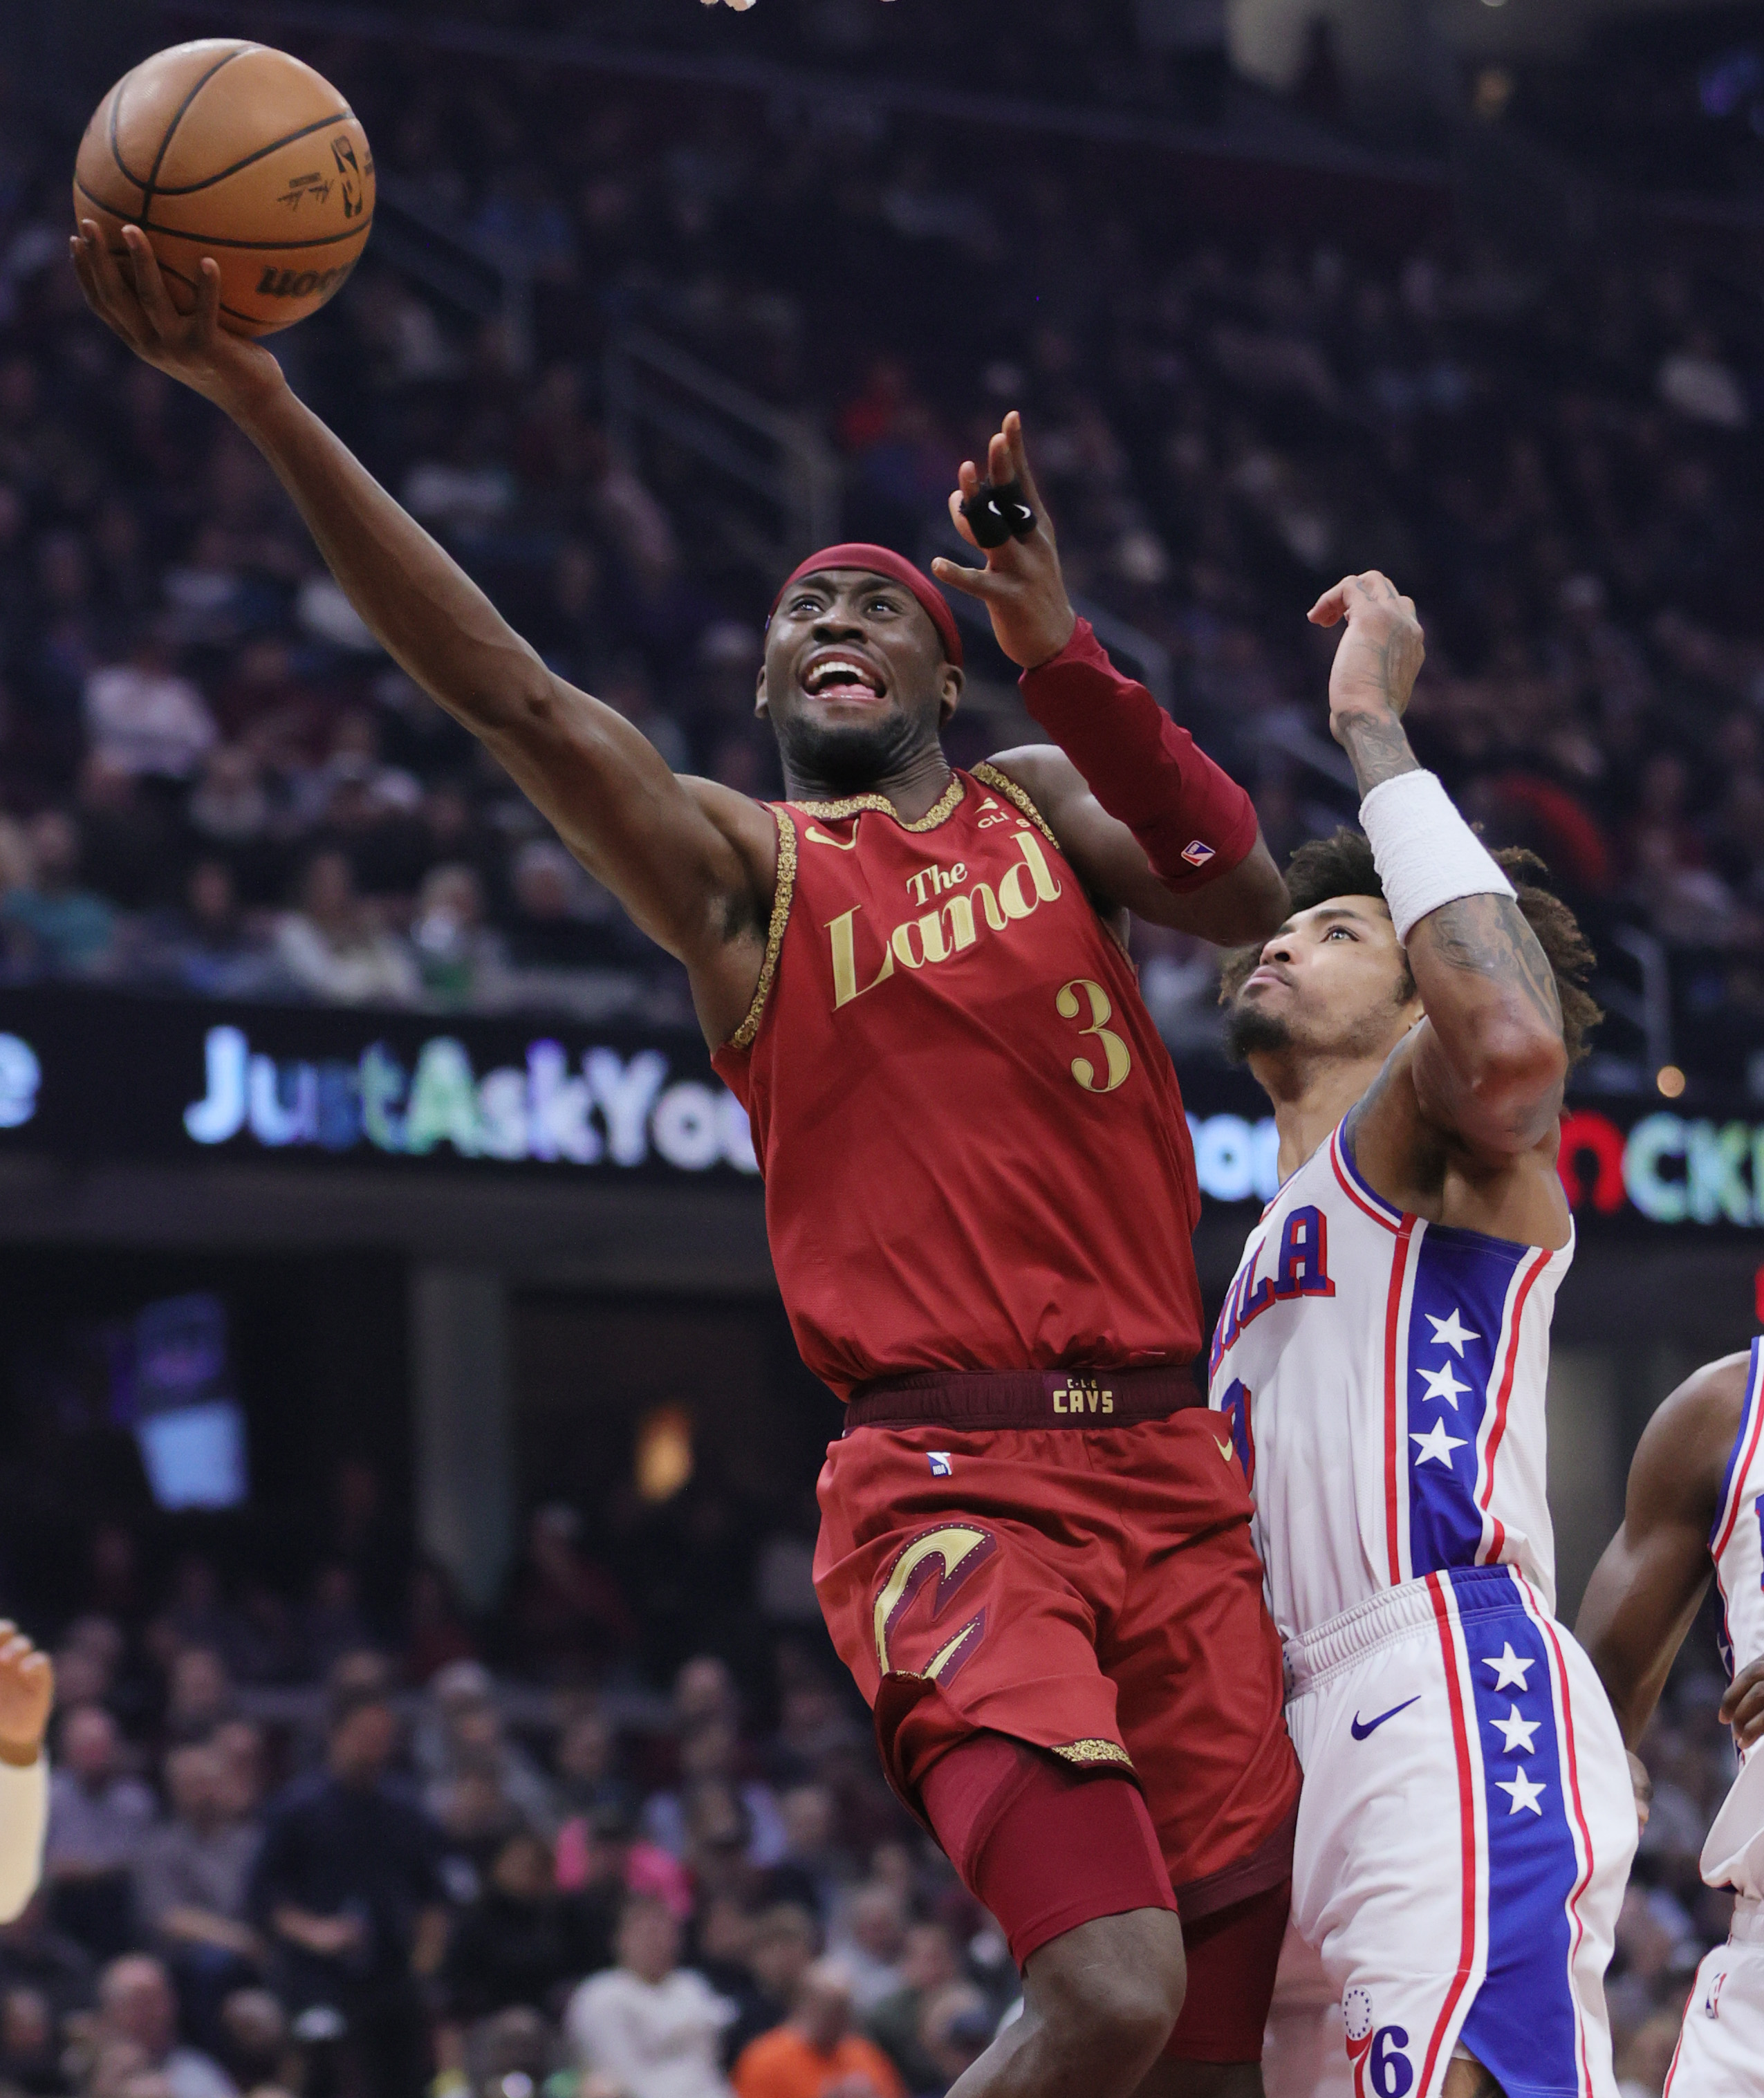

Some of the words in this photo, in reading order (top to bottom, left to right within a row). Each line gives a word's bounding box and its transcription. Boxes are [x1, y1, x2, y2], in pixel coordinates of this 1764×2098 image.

[977, 811, 1031, 828] CLIS
[823, 830, 1061, 1012] Land
[906, 862, 968, 906] The
[1055, 978, 1131, 1093] 3
[1209, 1205, 1336, 1390] ILA
[1052, 1390, 1113, 1413] CAVS
